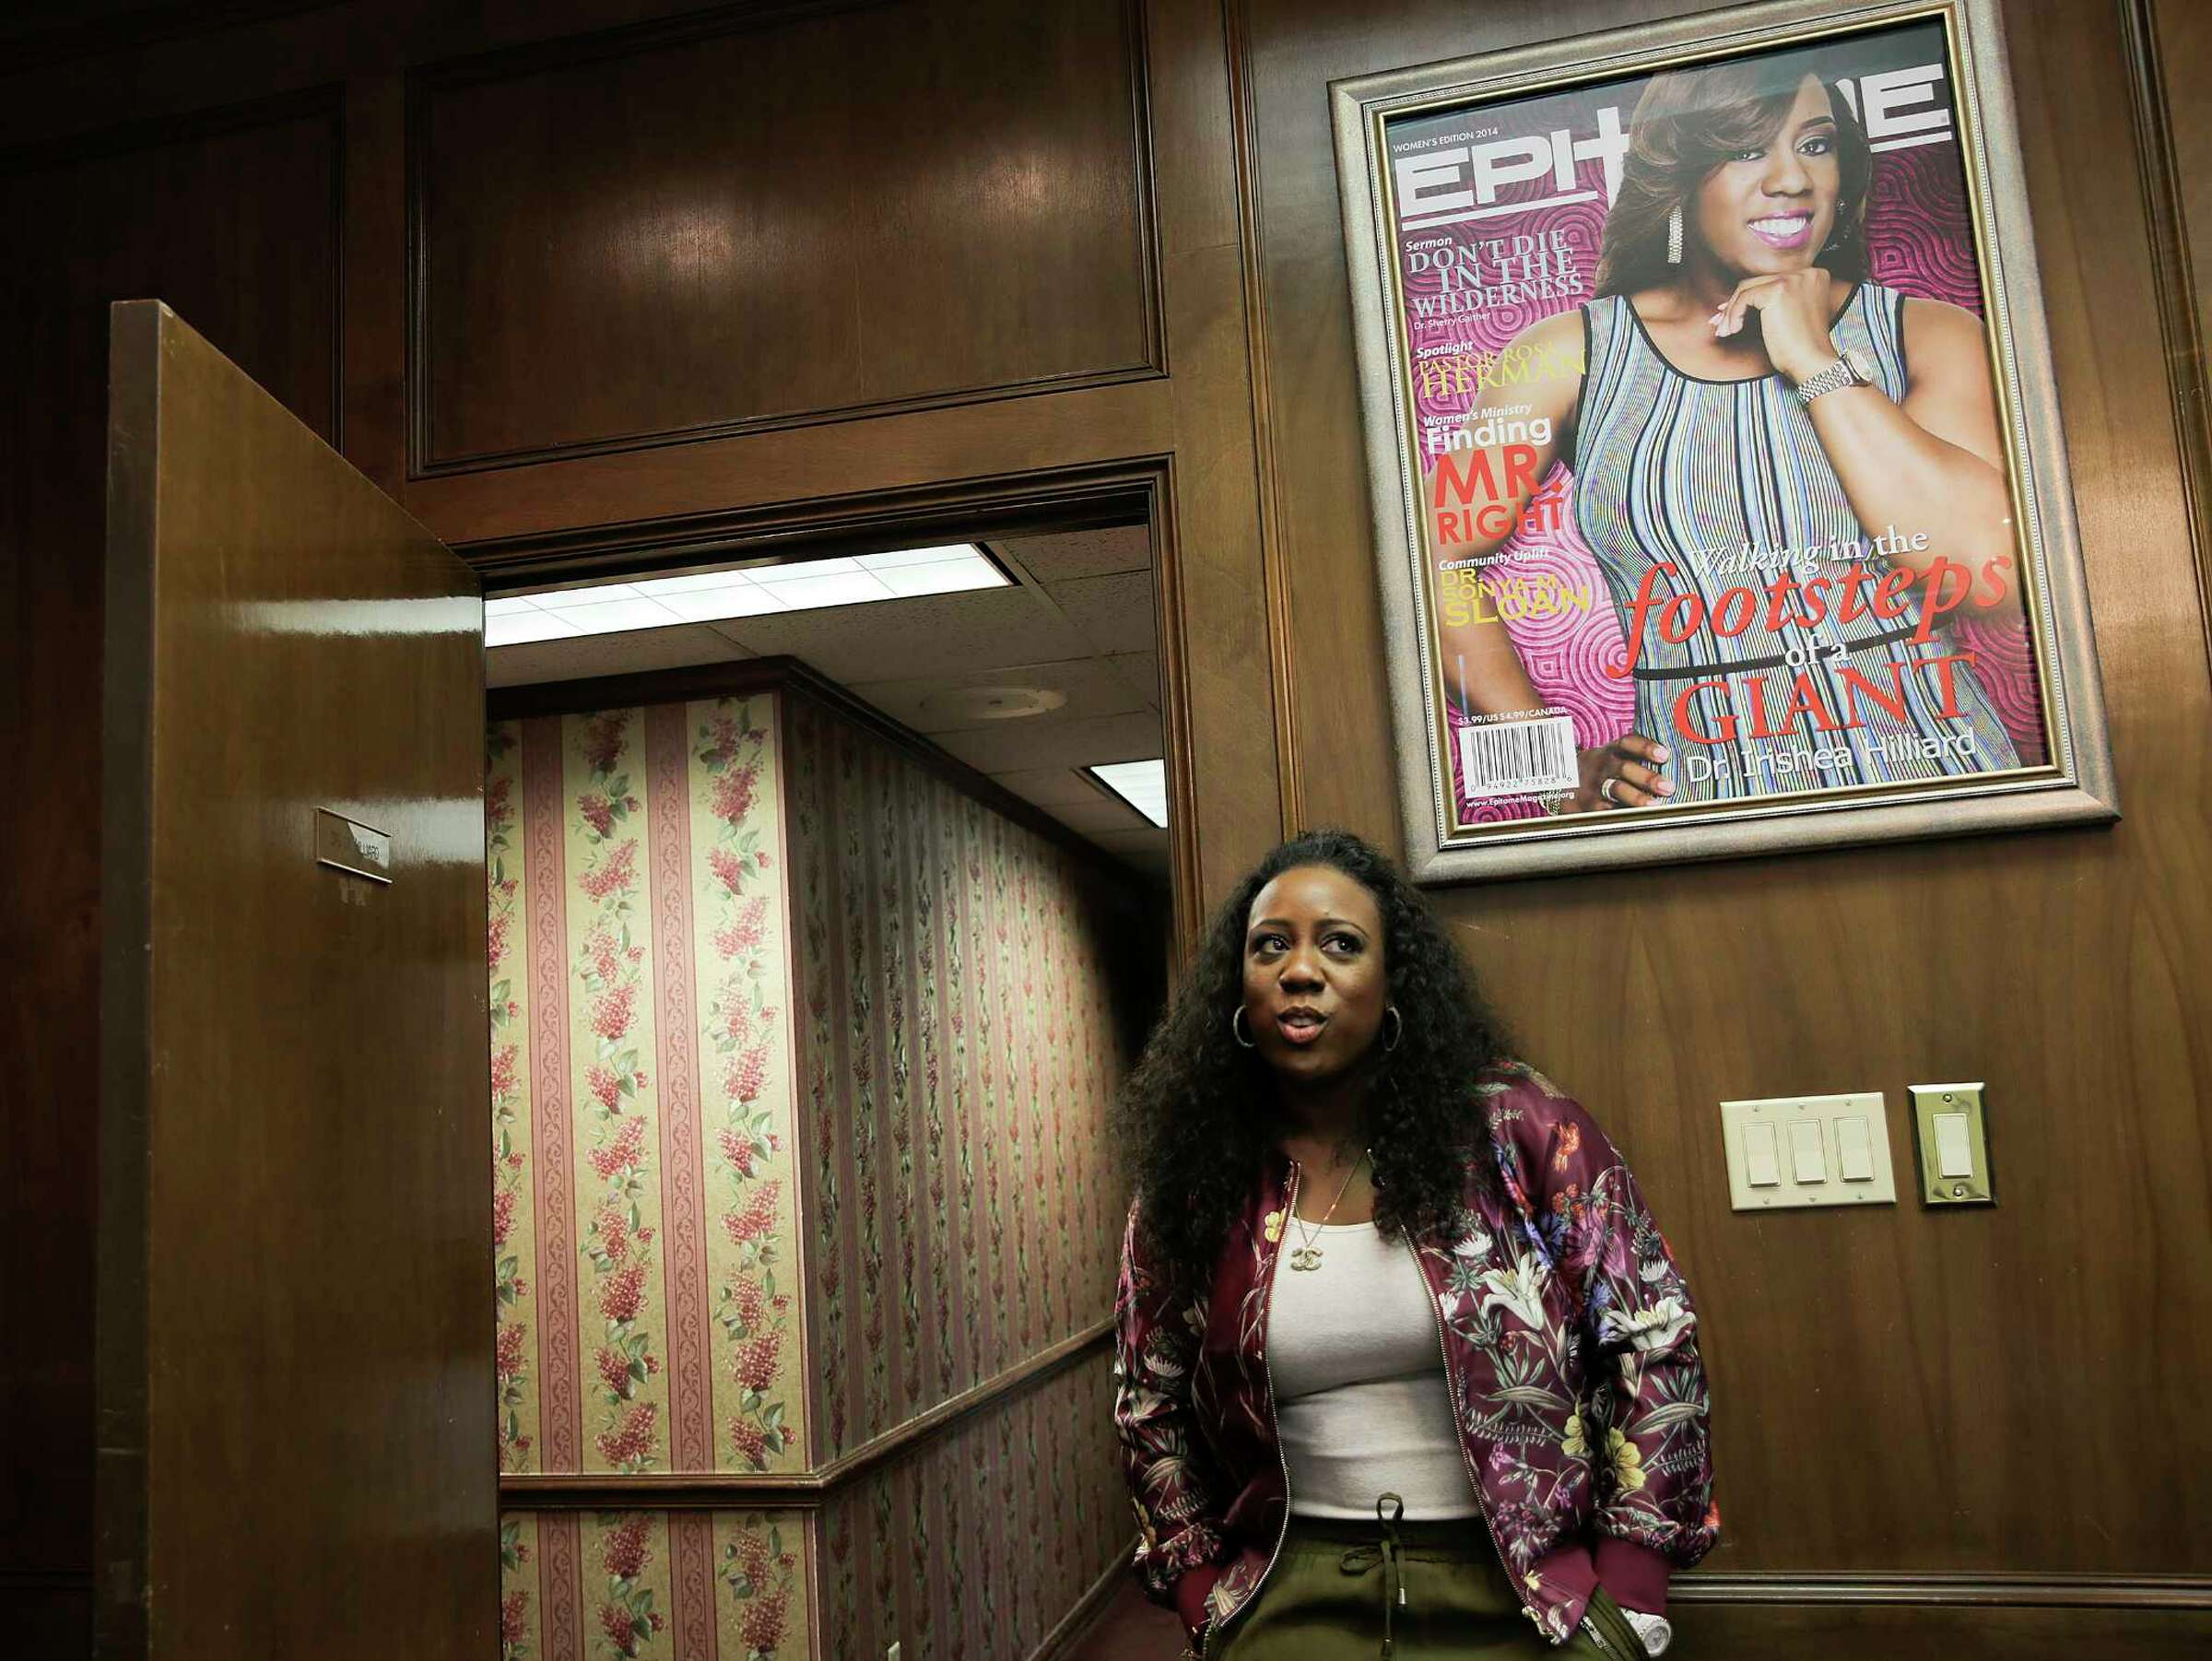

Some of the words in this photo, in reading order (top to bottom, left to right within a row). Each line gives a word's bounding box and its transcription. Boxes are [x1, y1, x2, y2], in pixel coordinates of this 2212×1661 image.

[1393, 137, 1438, 153] WOMEN'S
[1439, 131, 1475, 145] EDITION
[1476, 127, 1499, 138] 2014
[1405, 237, 1453, 252] Sermon
[1407, 239, 1506, 273] DON'T
[1512, 229, 1568, 256] DIE
[1437, 264, 1483, 293] IN
[1492, 248, 1578, 285] THE
[1411, 273, 1583, 318] WILDERNESS
[1414, 323, 1428, 331] Dr.
[1416, 340, 1474, 359] Spotlight
[1418, 351, 1498, 374] PASTOR
[1421, 348, 1586, 399] HERMAN
[1423, 410, 1478, 428] Women's
[1480, 403, 1534, 419] Ministry
[1426, 417, 1553, 454] Finding
[1437, 497, 1564, 546] RIGHT
[1438, 553, 1512, 571] Community
[1513, 548, 1549, 563] Uplift
[1690, 541, 1822, 579] Walking
[1830, 535, 1865, 561] in
[1874, 524, 1932, 557] the
[1606, 555, 2013, 678] footsteps
[1784, 634, 1824, 667] of
[1831, 642, 1852, 662] a
[1673, 650, 1977, 745] GIANT
[1687, 755, 1730, 783] Dr.
[1864, 726, 1977, 766] Hilliard
